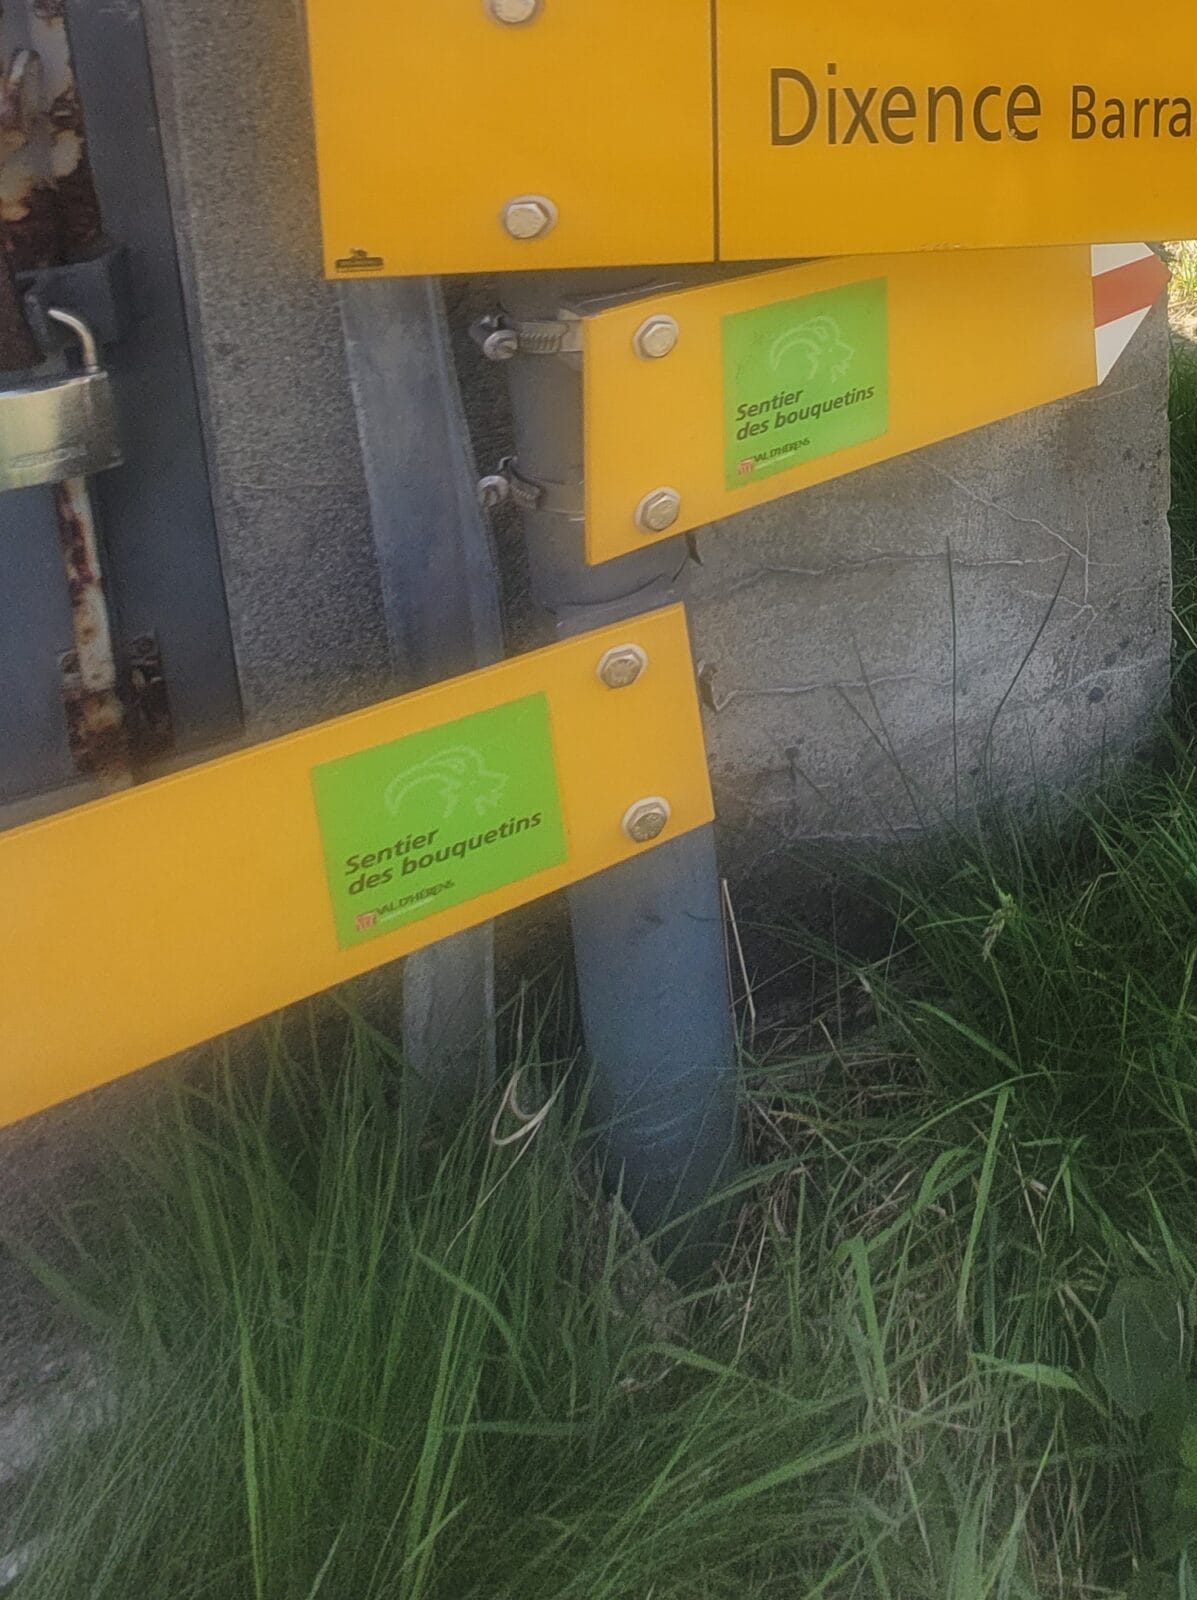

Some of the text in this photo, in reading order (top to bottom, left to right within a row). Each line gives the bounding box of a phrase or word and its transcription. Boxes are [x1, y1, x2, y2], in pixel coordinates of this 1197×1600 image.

[769, 62, 1043, 147] Dixence
[735, 389, 804, 422] Sentier
[736, 385, 875, 441] des bouquetins
[345, 829, 440, 876] Sentier
[347, 812, 542, 896] des bouquetins
